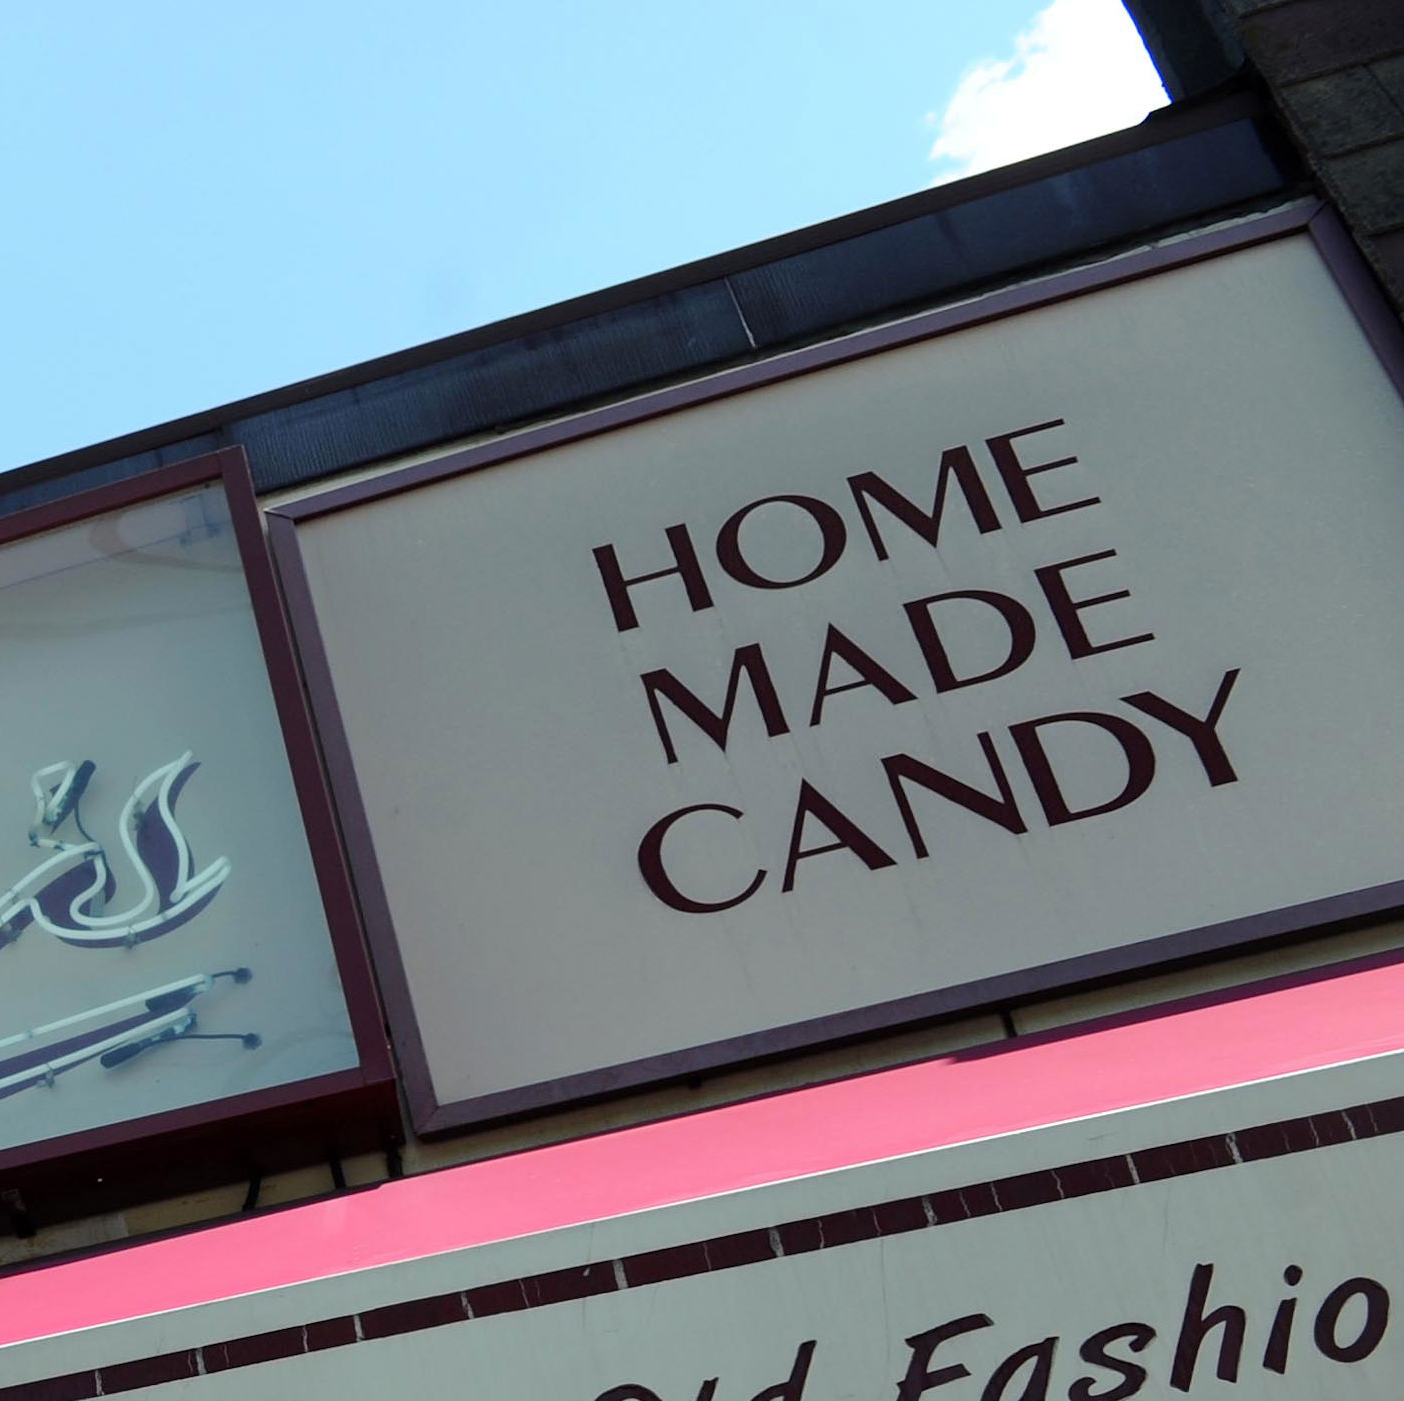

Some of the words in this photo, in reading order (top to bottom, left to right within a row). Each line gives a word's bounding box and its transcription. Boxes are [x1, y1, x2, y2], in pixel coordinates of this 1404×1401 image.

[593, 418, 1101, 633] HOME
[639, 548, 1155, 764] MADE
[637, 668, 1241, 914] CANDY
